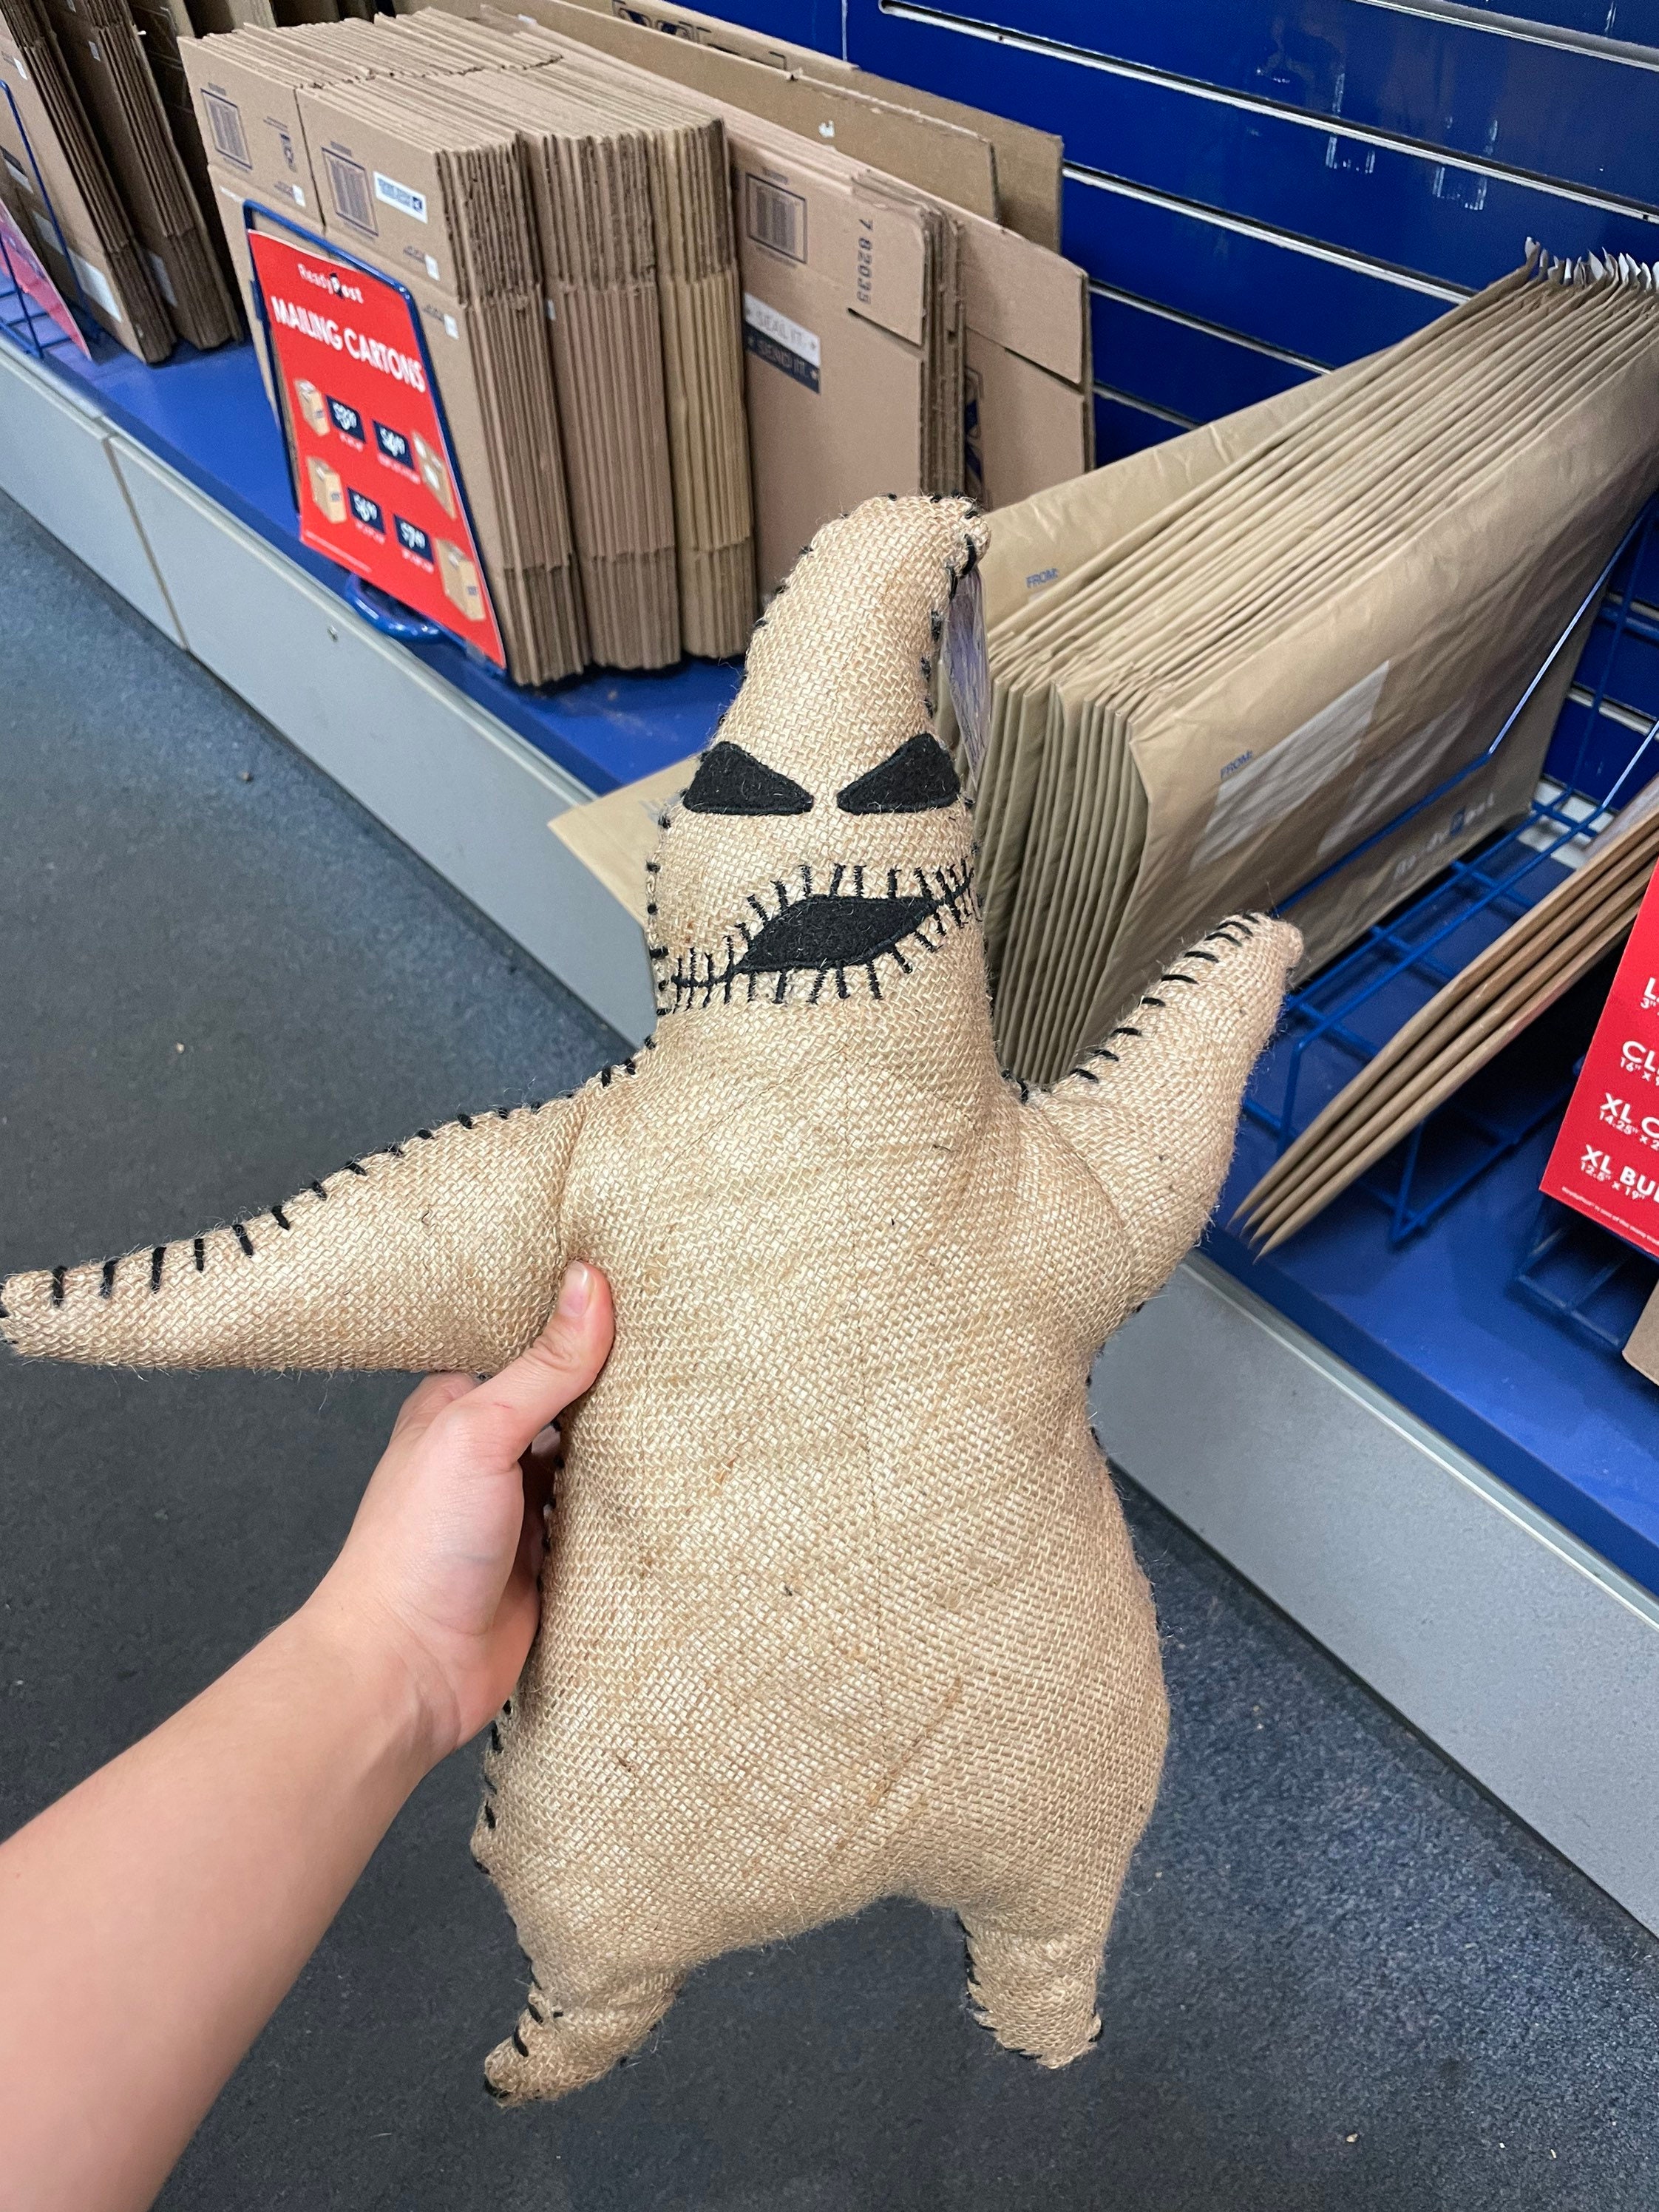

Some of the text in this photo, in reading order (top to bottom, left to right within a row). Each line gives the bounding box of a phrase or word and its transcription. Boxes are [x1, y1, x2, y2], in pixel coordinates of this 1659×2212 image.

[271, 296, 426, 393] MAILING CARTONS
[1643, 977, 1659, 1003] L
[1622, 1040, 1659, 1075] CL
[1599, 1092, 1632, 1124] XL
[1581, 1144, 1612, 1175] XL
